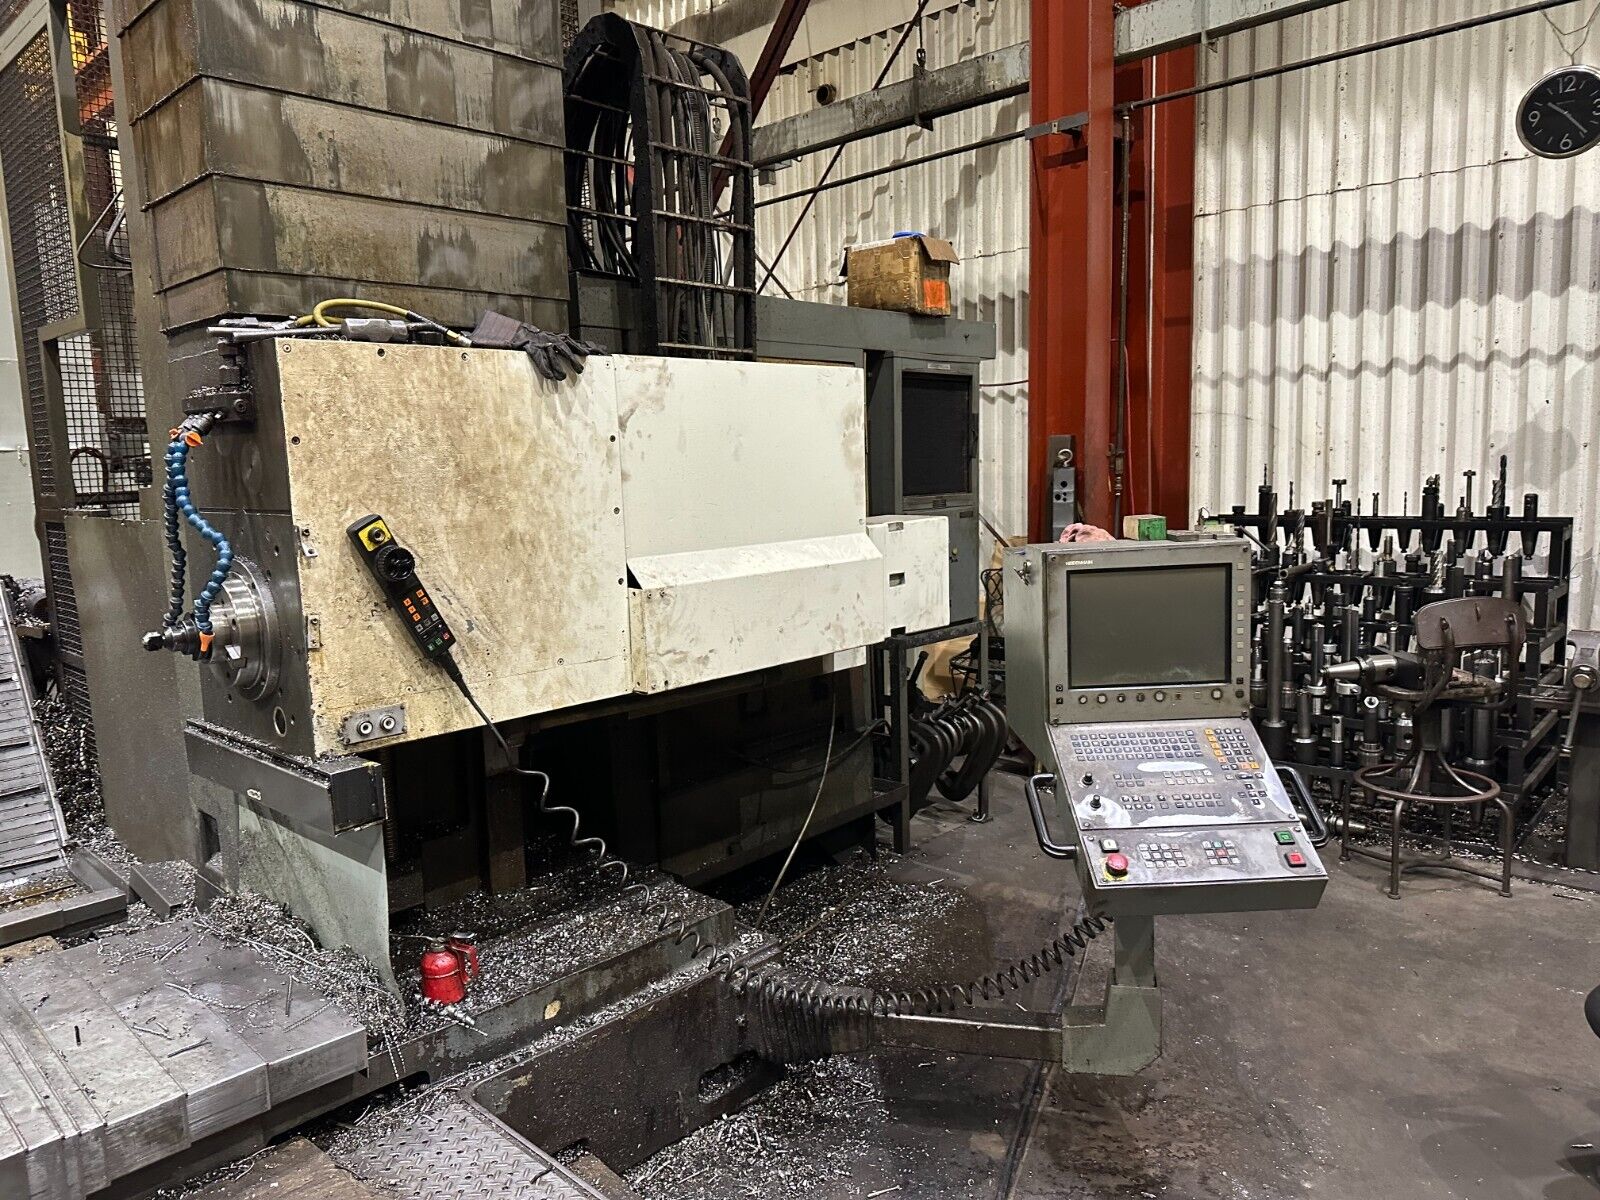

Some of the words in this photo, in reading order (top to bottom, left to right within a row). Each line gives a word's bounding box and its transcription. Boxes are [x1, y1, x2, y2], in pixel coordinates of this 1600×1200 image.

[1557, 75, 1576, 93] 12
[1528, 110, 1540, 127] 9
[1560, 133, 1572, 149] 6
